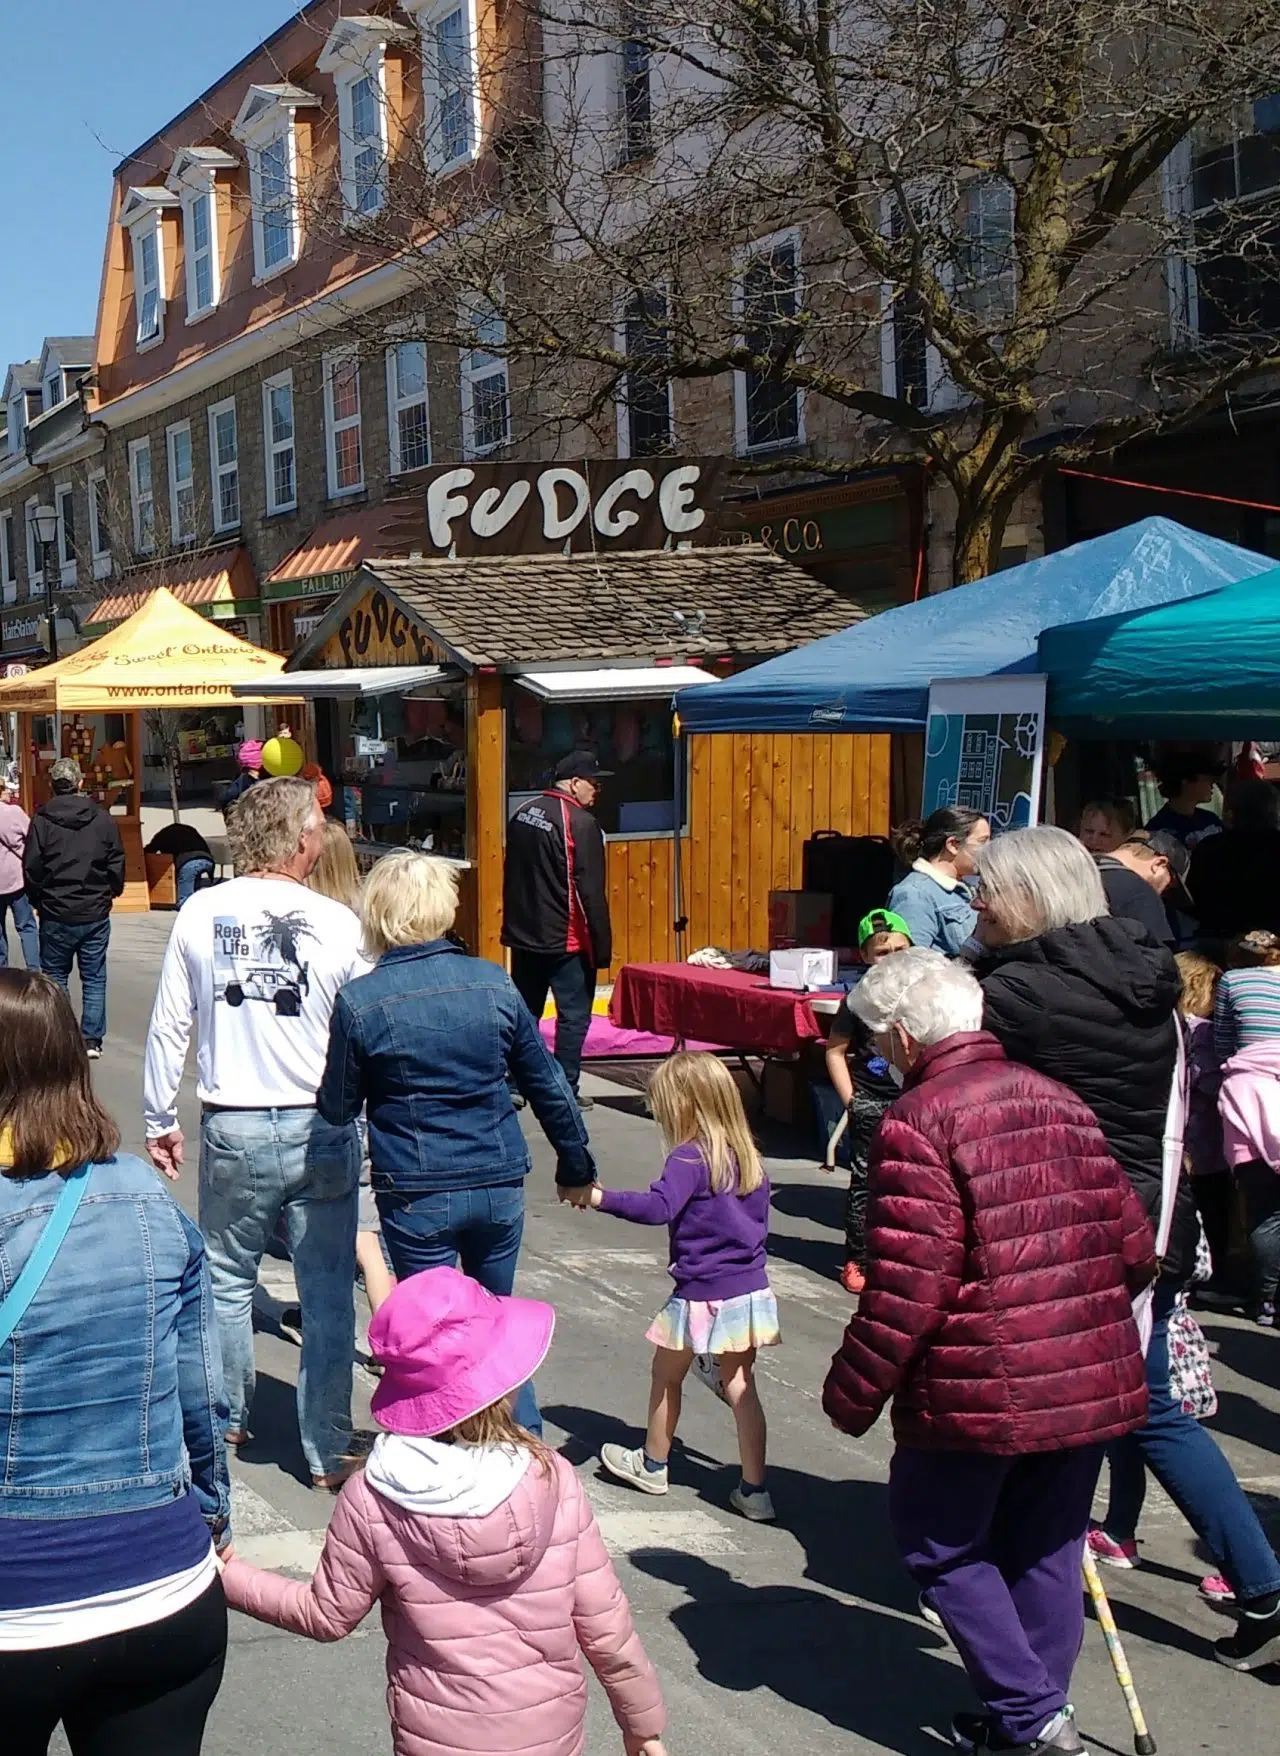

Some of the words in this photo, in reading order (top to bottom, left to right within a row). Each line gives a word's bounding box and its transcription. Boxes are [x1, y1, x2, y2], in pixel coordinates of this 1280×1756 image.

[427, 465, 705, 548] FUDGE
[302, 575, 330, 594] FALL
[339, 590, 434, 667] FUDGE
[182, 643, 255, 656] Ontario
[214, 923, 247, 939] Reel
[222, 939, 250, 956] Life
